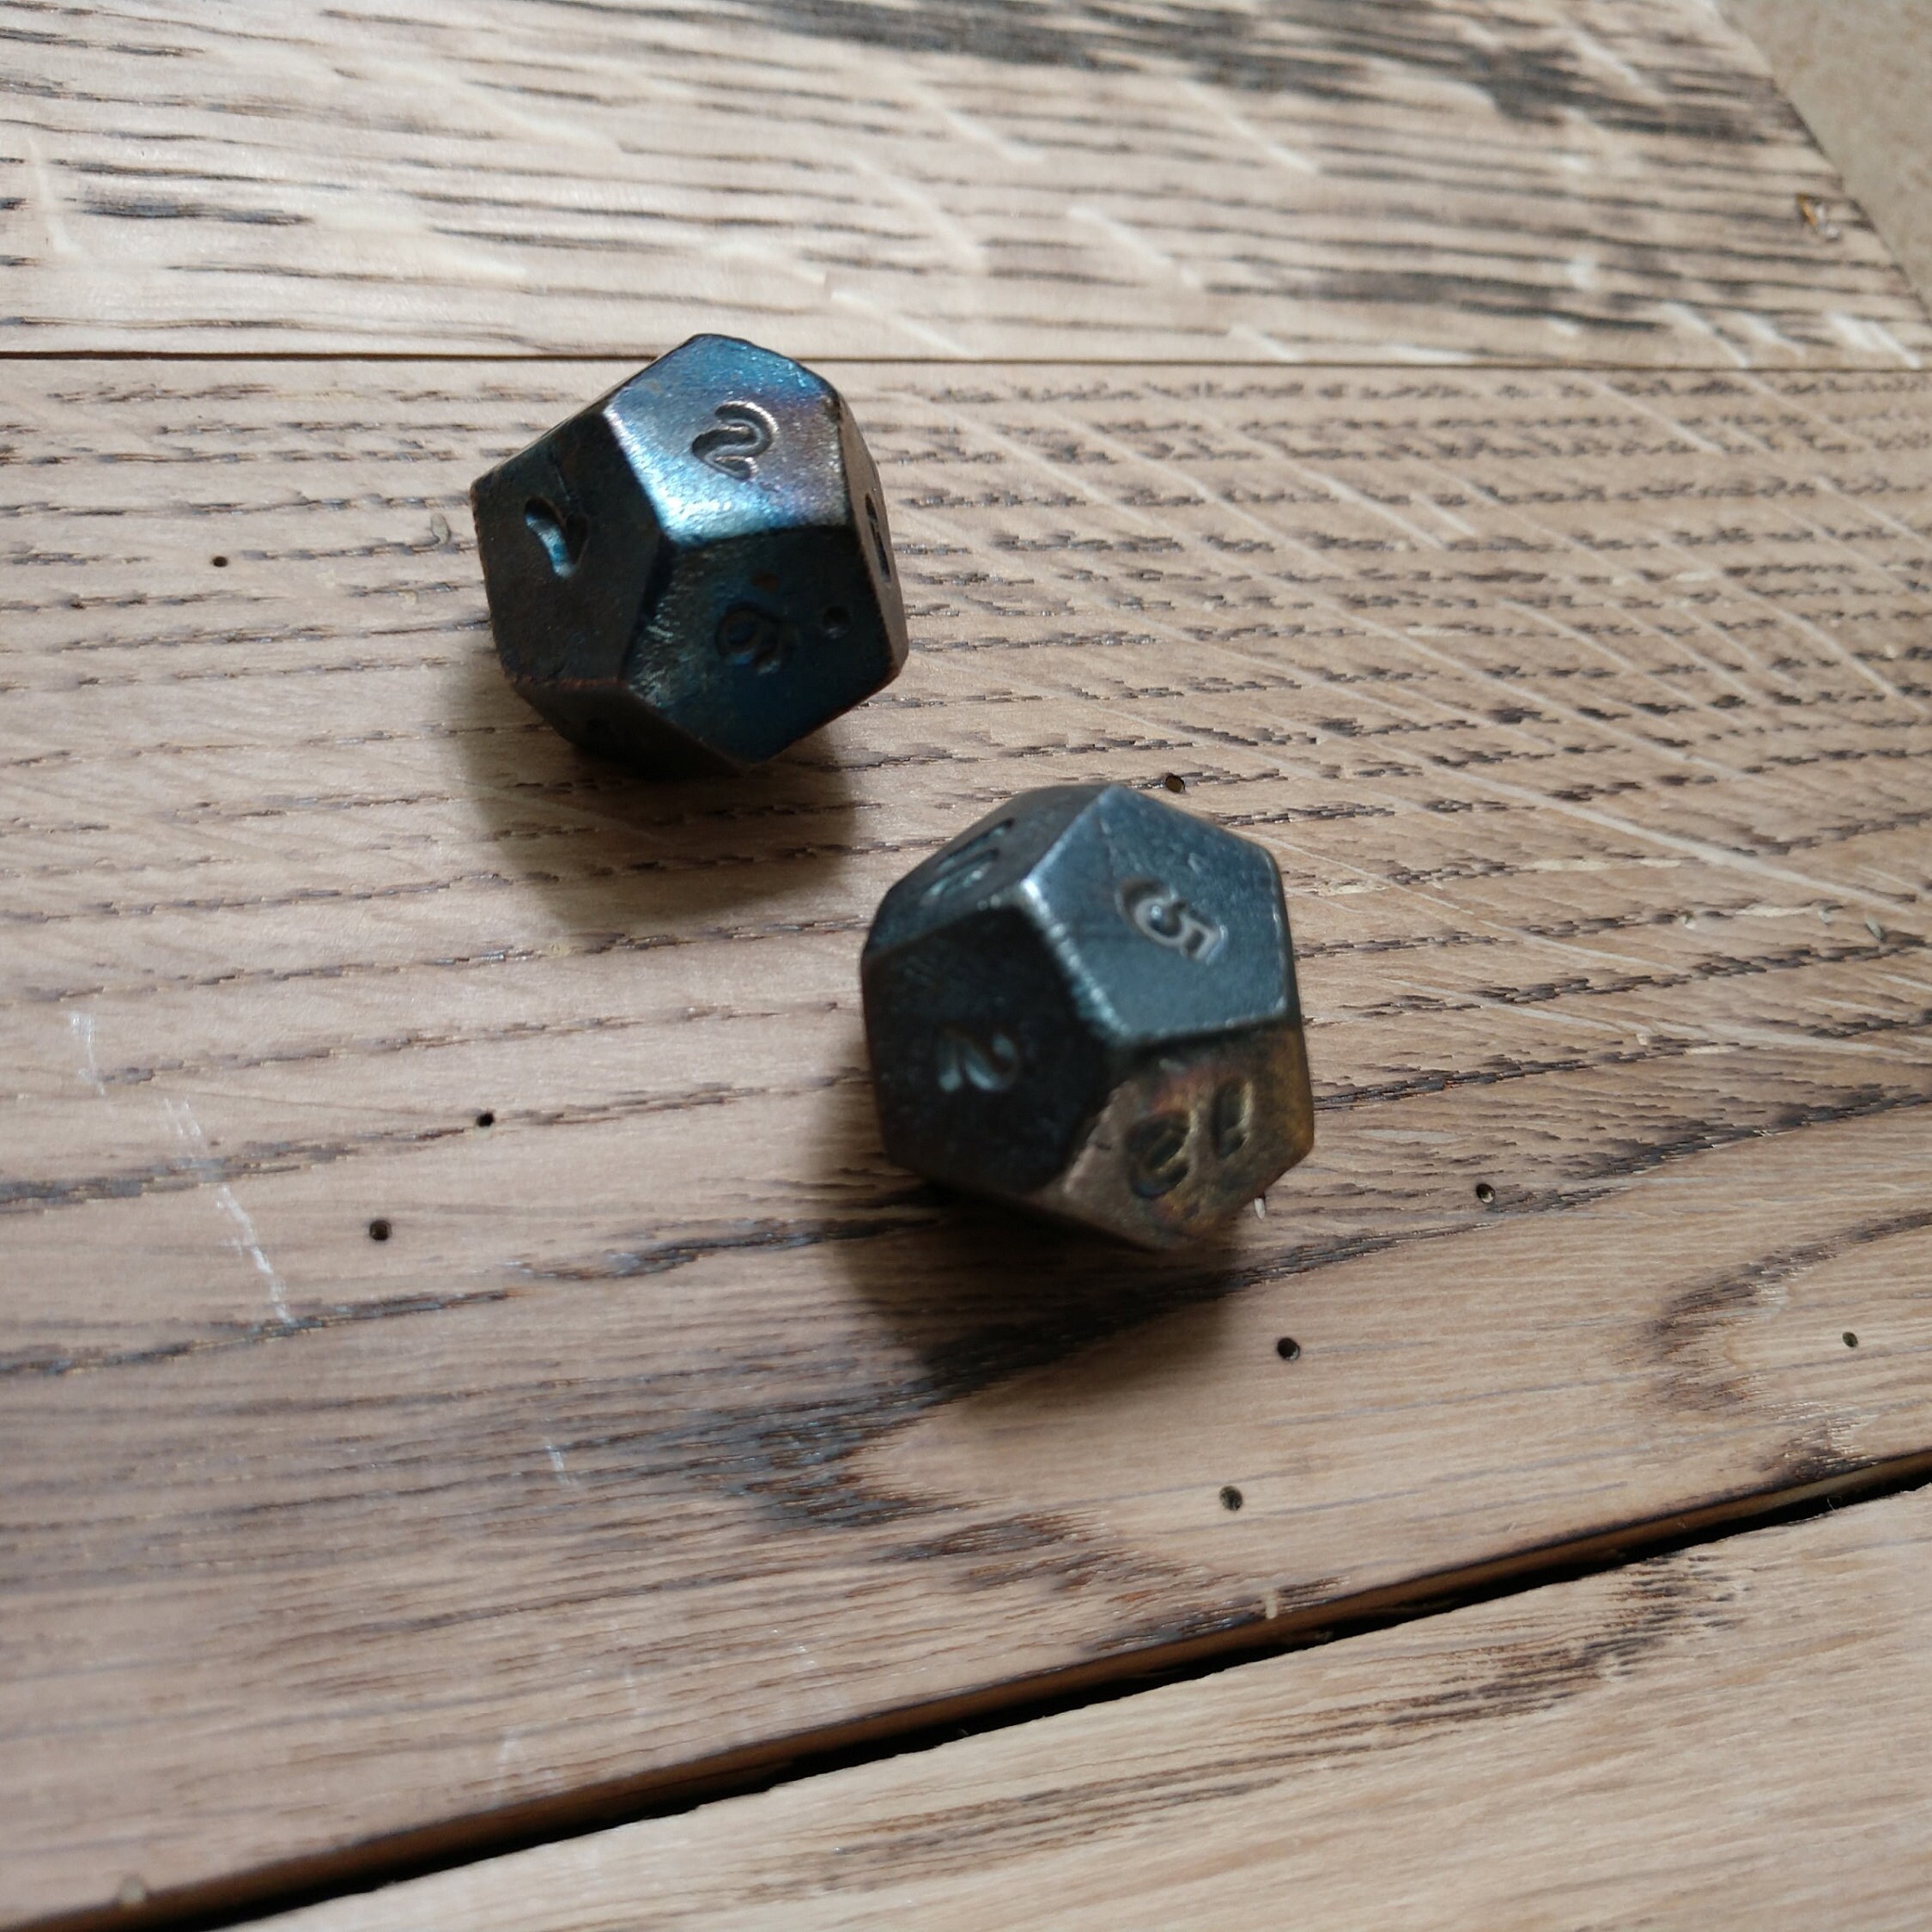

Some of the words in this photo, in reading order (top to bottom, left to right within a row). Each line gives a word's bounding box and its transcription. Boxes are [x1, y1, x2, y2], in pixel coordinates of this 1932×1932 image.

[691, 401, 780, 480] 2
[1115, 876, 1228, 965] 5
[937, 1023, 1024, 1093] 2
